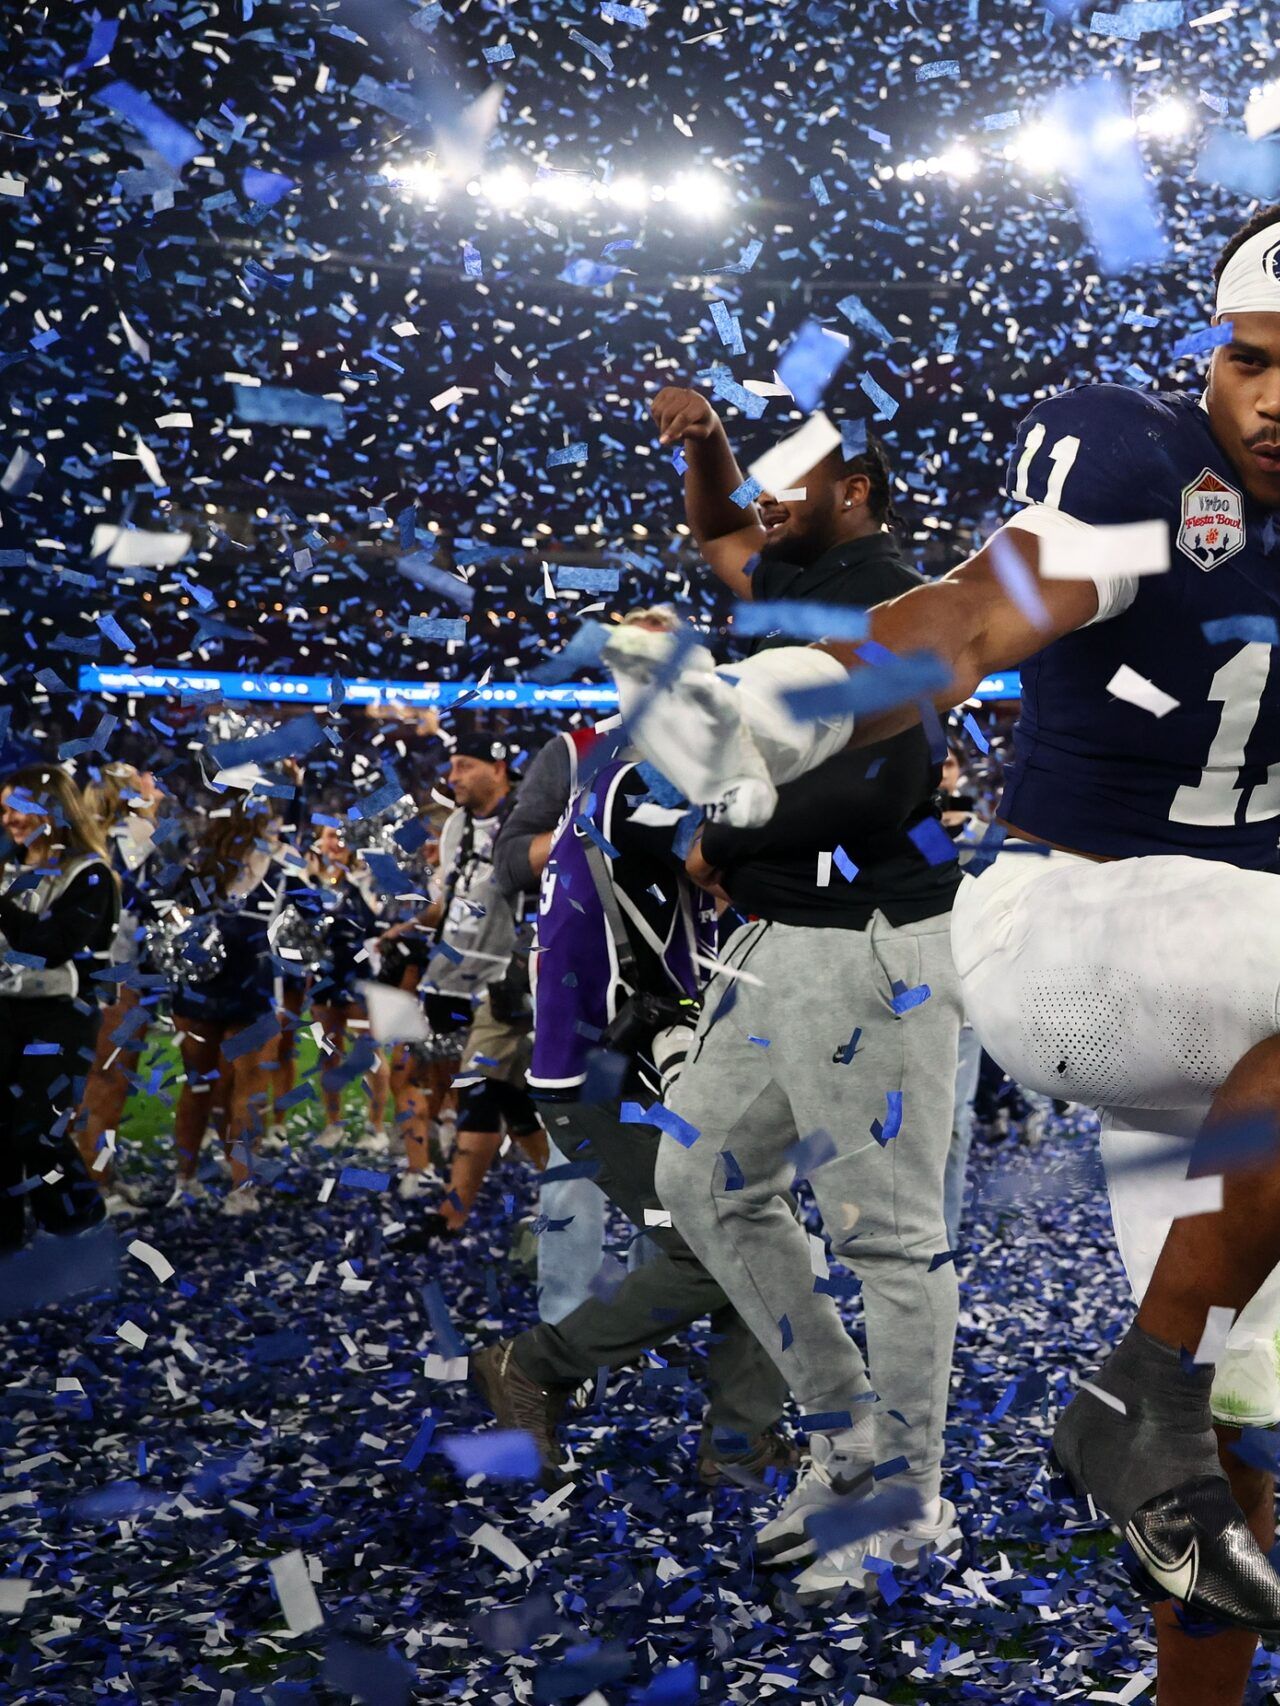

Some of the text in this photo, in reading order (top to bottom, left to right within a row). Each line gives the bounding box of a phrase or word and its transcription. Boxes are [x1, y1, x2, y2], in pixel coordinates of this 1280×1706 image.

[1011, 422, 1081, 510] 11
[1185, 513, 1242, 531] Fiesta Bowl
